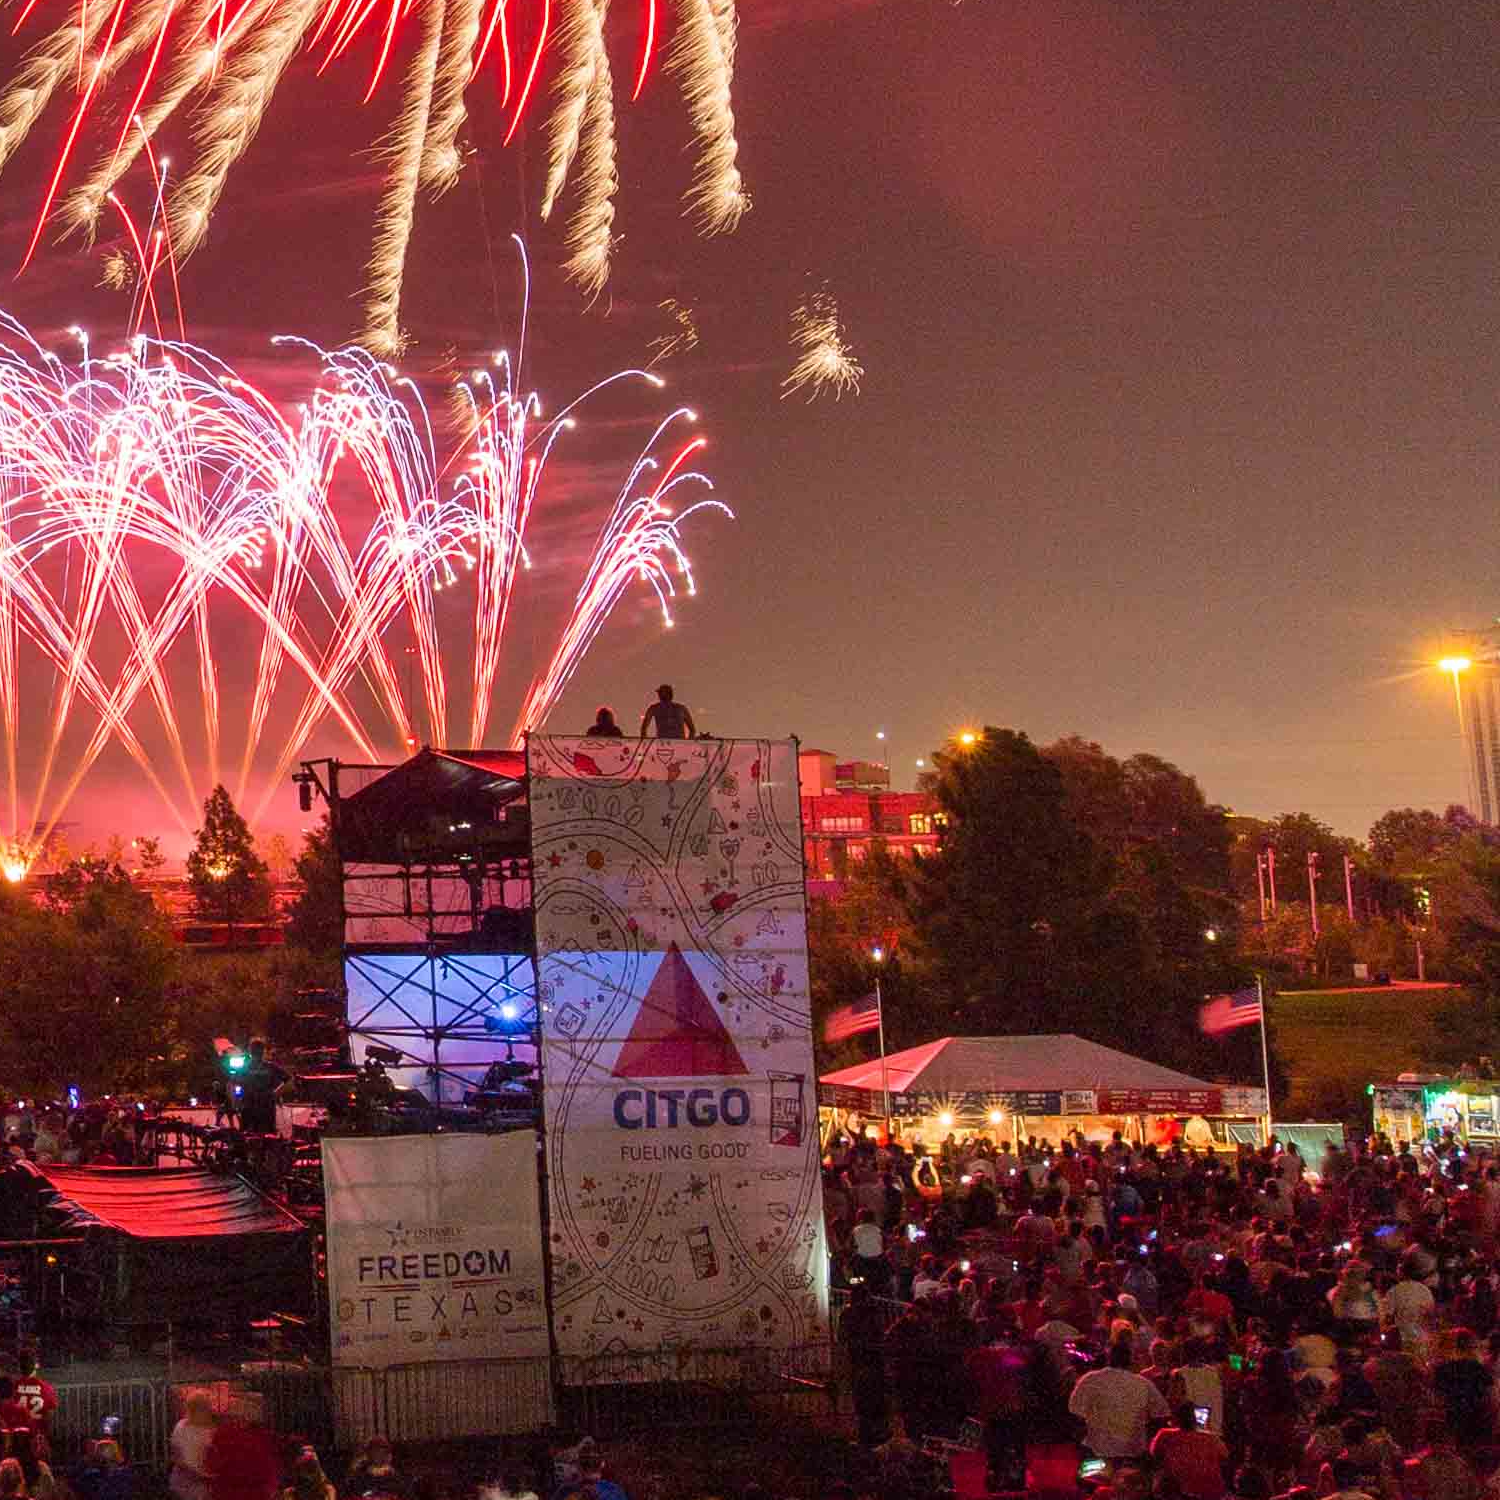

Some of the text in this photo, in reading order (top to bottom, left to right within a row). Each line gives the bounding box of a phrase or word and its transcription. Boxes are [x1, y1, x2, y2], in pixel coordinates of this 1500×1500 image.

[613, 1088, 750, 1128] CITGO
[621, 1143, 748, 1161] FUELING GOOD
[359, 1250, 511, 1281] FREEDOM
[360, 1289, 513, 1324] TEXAS
